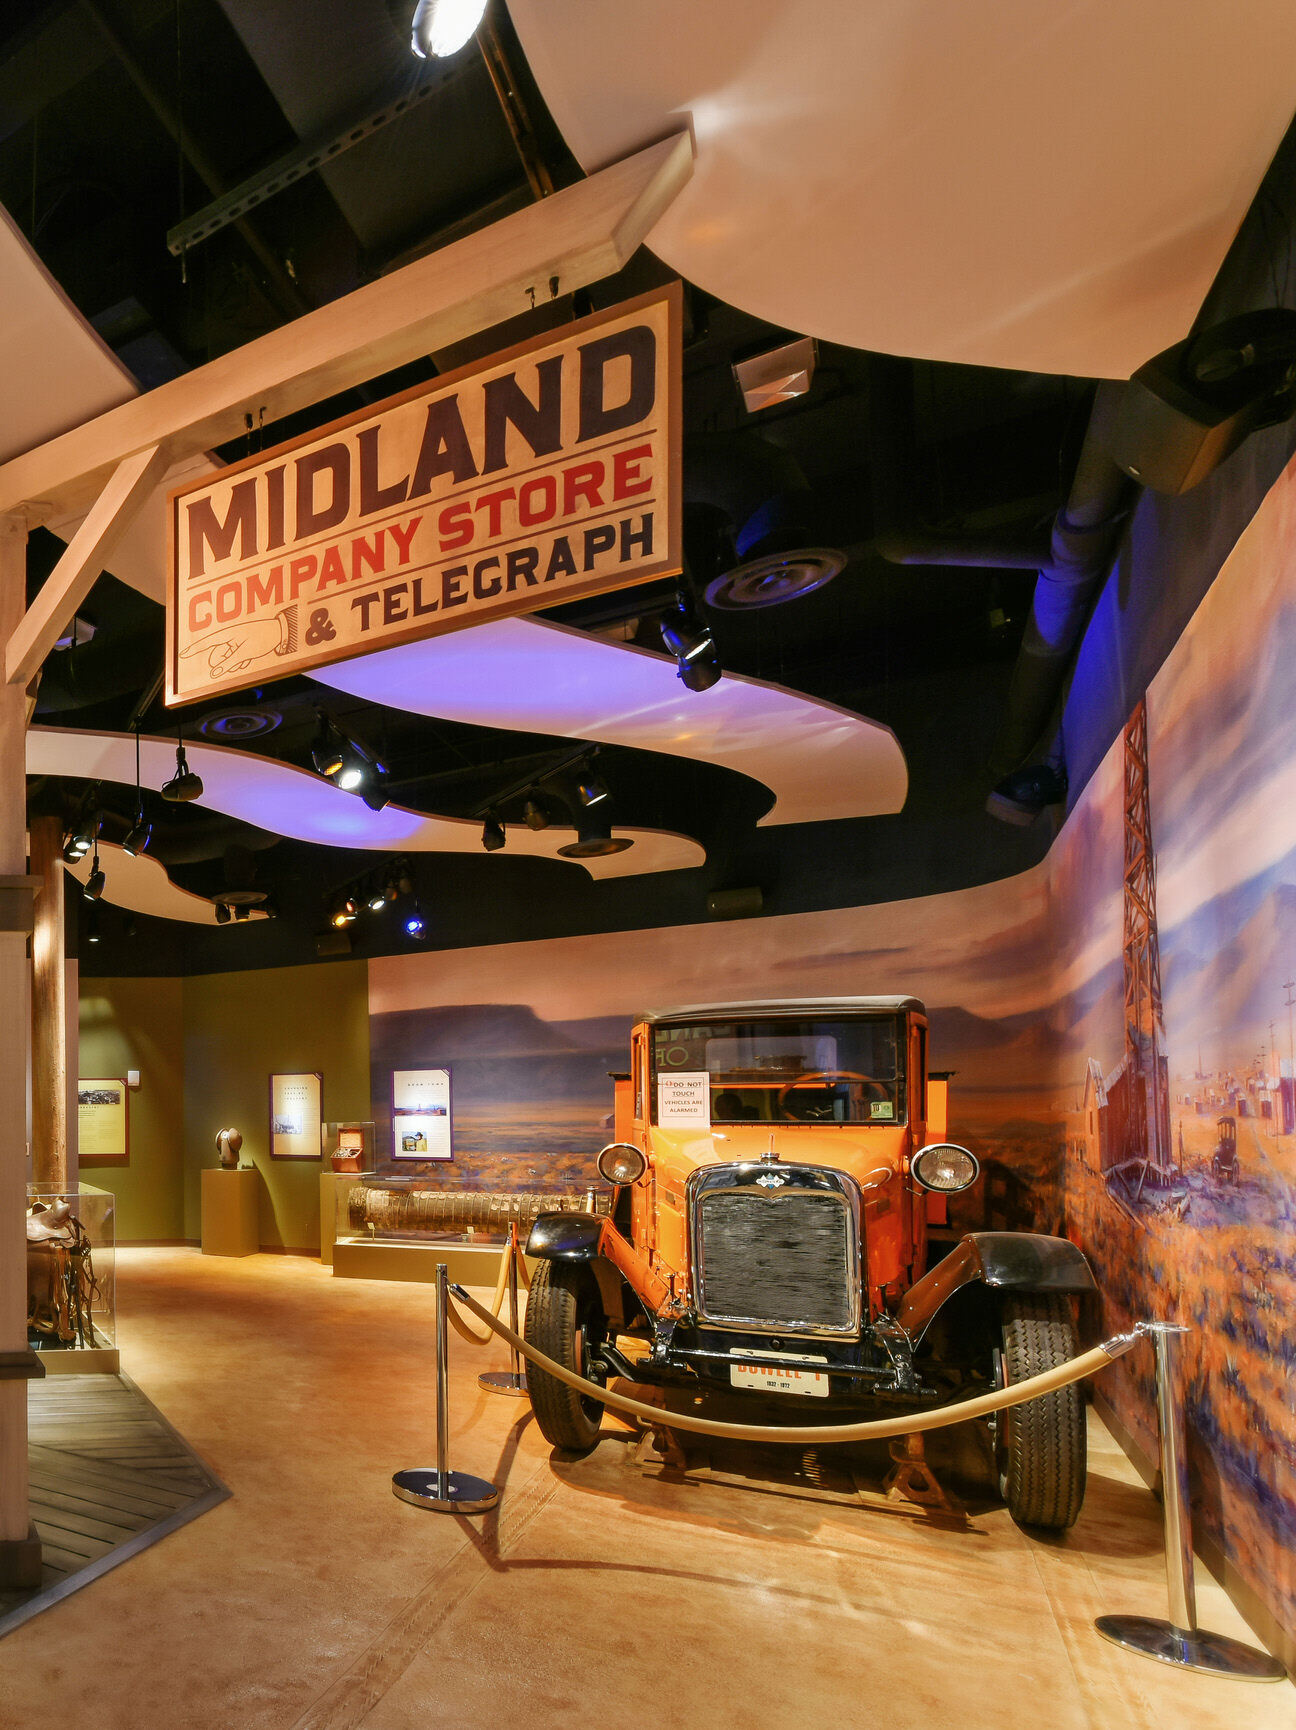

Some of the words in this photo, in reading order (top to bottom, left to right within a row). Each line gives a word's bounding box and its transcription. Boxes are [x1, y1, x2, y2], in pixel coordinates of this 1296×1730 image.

[186, 325, 656, 580] MIDLAND
[188, 515, 423, 633] COMPANY
[438, 443, 653, 552] STORE
[305, 607, 336, 647] &
[350, 512, 654, 632] TELEGRAPH
